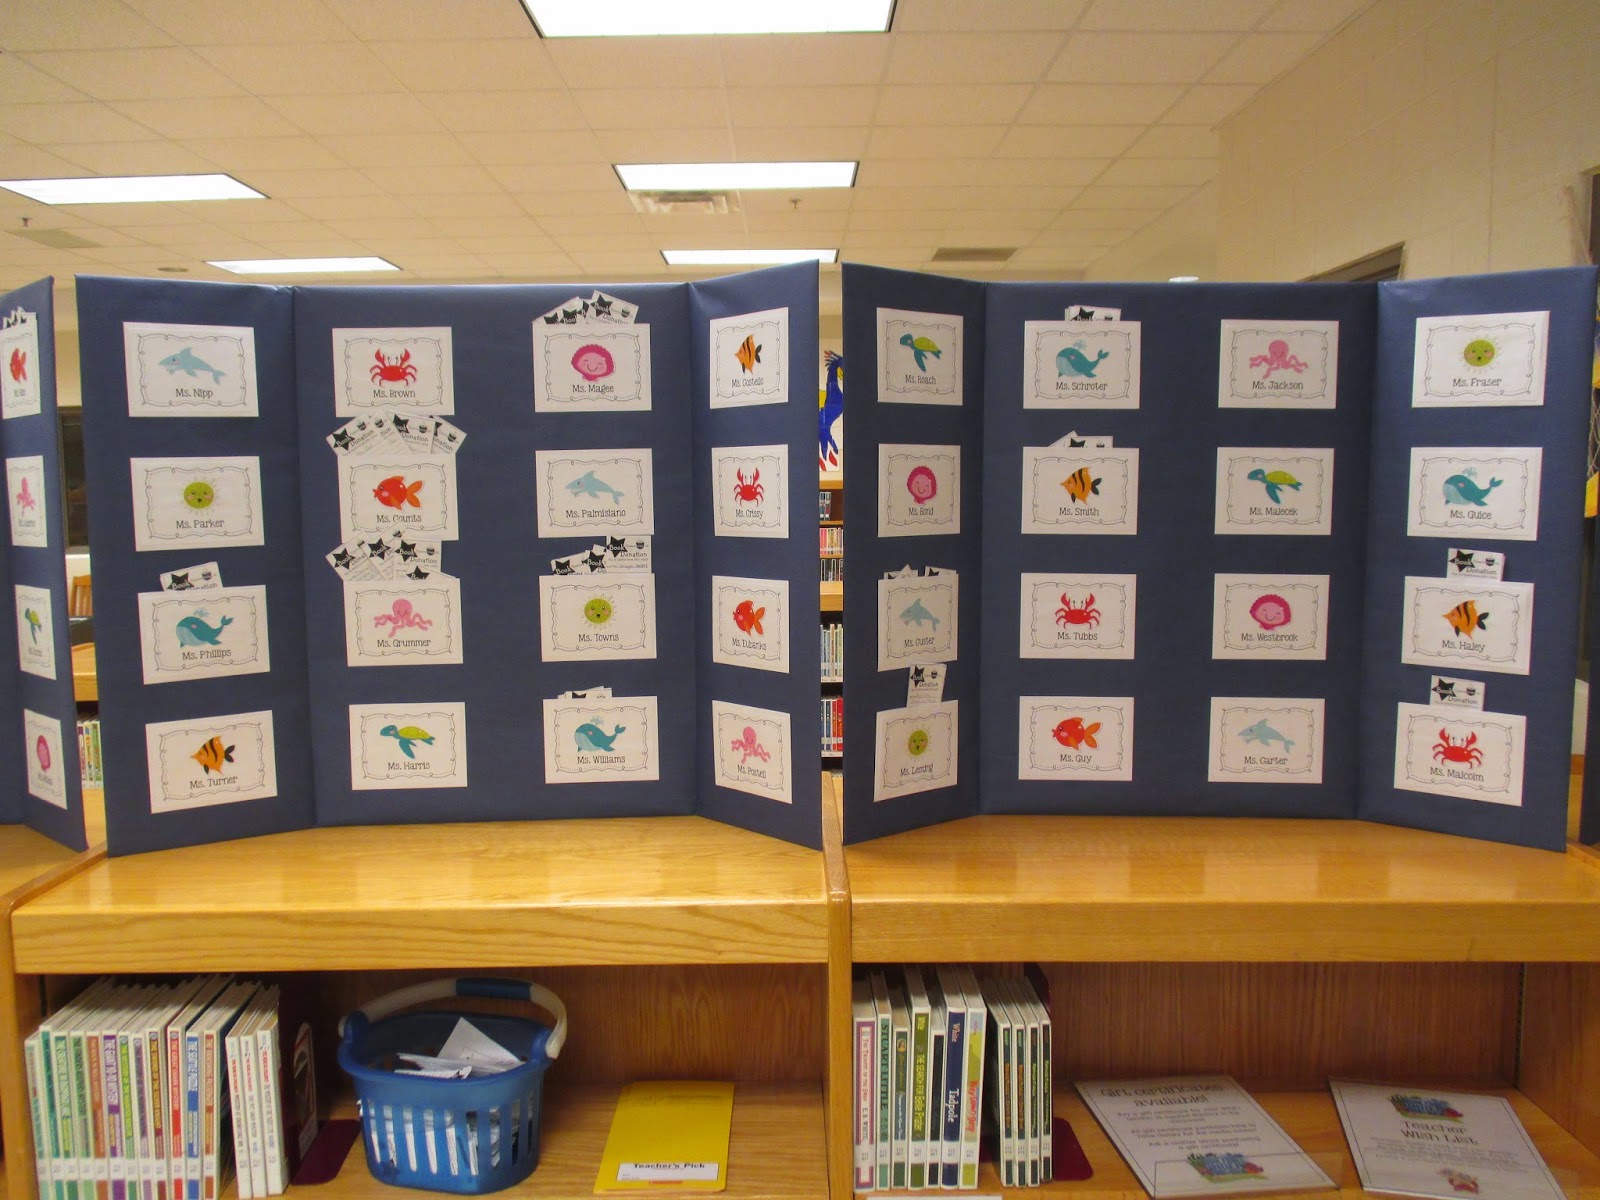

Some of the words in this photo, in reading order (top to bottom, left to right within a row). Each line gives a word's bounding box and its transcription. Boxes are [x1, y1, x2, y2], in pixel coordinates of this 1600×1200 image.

[905, 375, 916, 384] Ms.
[1453, 378, 1468, 387] Ms.
[1470, 378, 1502, 387] Fraser
[572, 384, 586, 393] Ms.
[588, 384, 614, 394] Magee
[1056, 382, 1070, 390] Ms.
[1072, 382, 1108, 391] Schroter
[1252, 381, 1266, 390] Ms.
[1268, 381, 1303, 390] Jackson
[176, 389, 190, 397] Ms.
[193, 389, 213, 399] Nipp
[373, 389, 387, 398] Ms.
[390, 389, 416, 398] Brown
[401, 432, 428, 443] Donation
[566, 510, 579, 518] Ms.
[735, 509, 745, 518] Ms.
[908, 507, 918, 516] Ms.
[1059, 507, 1073, 516] Ms.
[1074, 507, 1099, 516] Smith
[1249, 507, 1263, 516] Ms.
[1450, 510, 1465, 519] Ms.
[376, 515, 391, 523] Ms.
[176, 520, 191, 529] Ms.
[193, 519, 224, 528] Parker
[399, 547, 415, 556] Book
[608, 543, 626, 551] Book
[410, 556, 438, 564] Donation
[587, 558, 603, 567] Book
[1466, 567, 1497, 575] Donation
[578, 634, 592, 642] Ms.
[594, 633, 620, 642] Towns
[1057, 632, 1071, 640] Ms.
[1073, 632, 1098, 640] Tubbs
[1241, 633, 1255, 641] Ms.
[377, 639, 391, 647] Ms.
[393, 639, 432, 647] Grummer
[1442, 640, 1457, 649] Ms.
[1459, 641, 1486, 653] Haley
[182, 652, 198, 660] Ms.
[200, 648, 232, 659] Phillips
[1448, 696, 1478, 705] Donation
[577, 756, 591, 764] Ms.
[593, 755, 626, 764] Williams
[1060, 754, 1074, 762] Ms.
[1075, 754, 1092, 763] Guy
[1244, 757, 1258, 765] Ms.
[1260, 756, 1288, 765] Carter
[388, 762, 402, 770] Ms.
[403, 761, 430, 770] Harris
[1430, 766, 1445, 777] Ms.
[1447, 769, 1484, 782] Malcolm
[190, 780, 205, 789] Ms.
[207, 776, 238, 787] Turner
[918, 1017, 926, 1030] White
[951, 1023, 961, 1042] White
[881, 1024, 889, 1068] STUART
[917, 1054, 925, 1063] THE
[916, 1065, 924, 1084] SEARCH
[881, 1071, 889, 1110] LITTLE
[1101, 1088, 1132, 1097] Gift
[1134, 1085, 1223, 1096] certificates
[945, 1089, 960, 1123] Tadpole
[1404, 1121, 1468, 1134] Teacher
[1401, 1129, 1440, 1141] Wish
[1444, 1134, 1479, 1145] List
